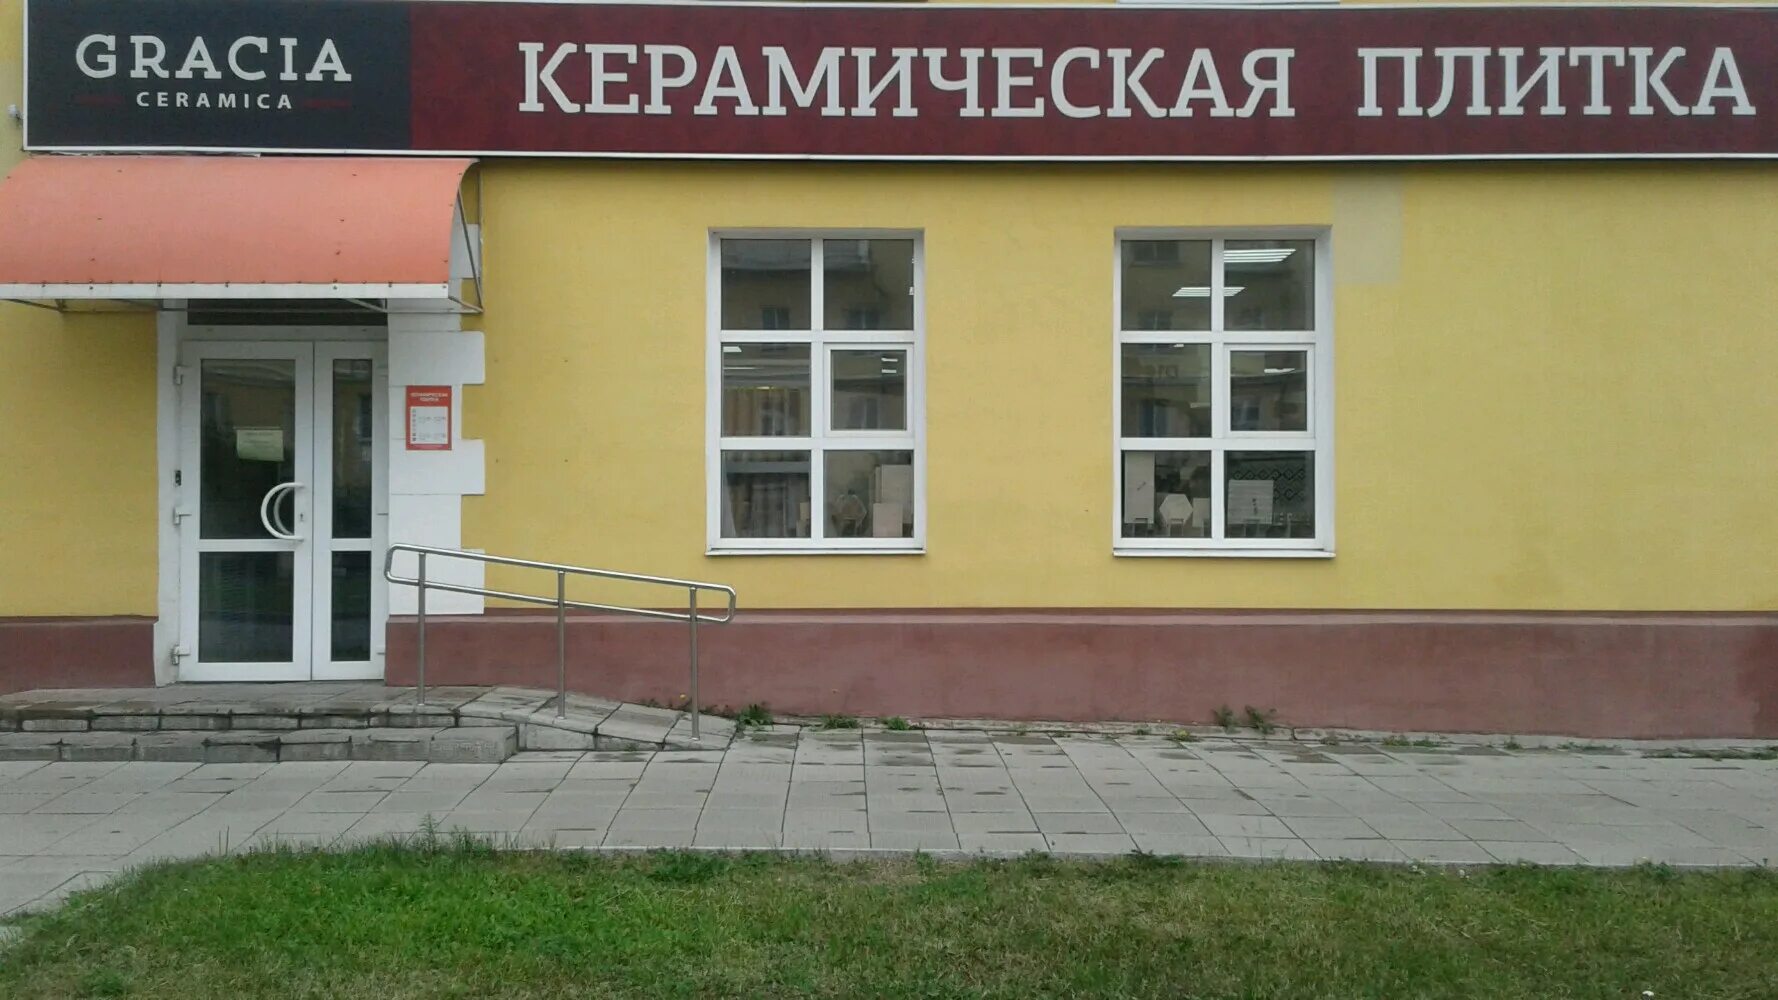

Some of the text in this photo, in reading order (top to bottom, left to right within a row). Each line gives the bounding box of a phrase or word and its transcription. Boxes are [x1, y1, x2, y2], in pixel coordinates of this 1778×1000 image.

[75, 33, 352, 82] GRACIA
[518, 42, 1757, 119] КЕРАМИЧЕСКАЯ ПЛИТКА
[135, 91, 293, 110] CERAMICA
